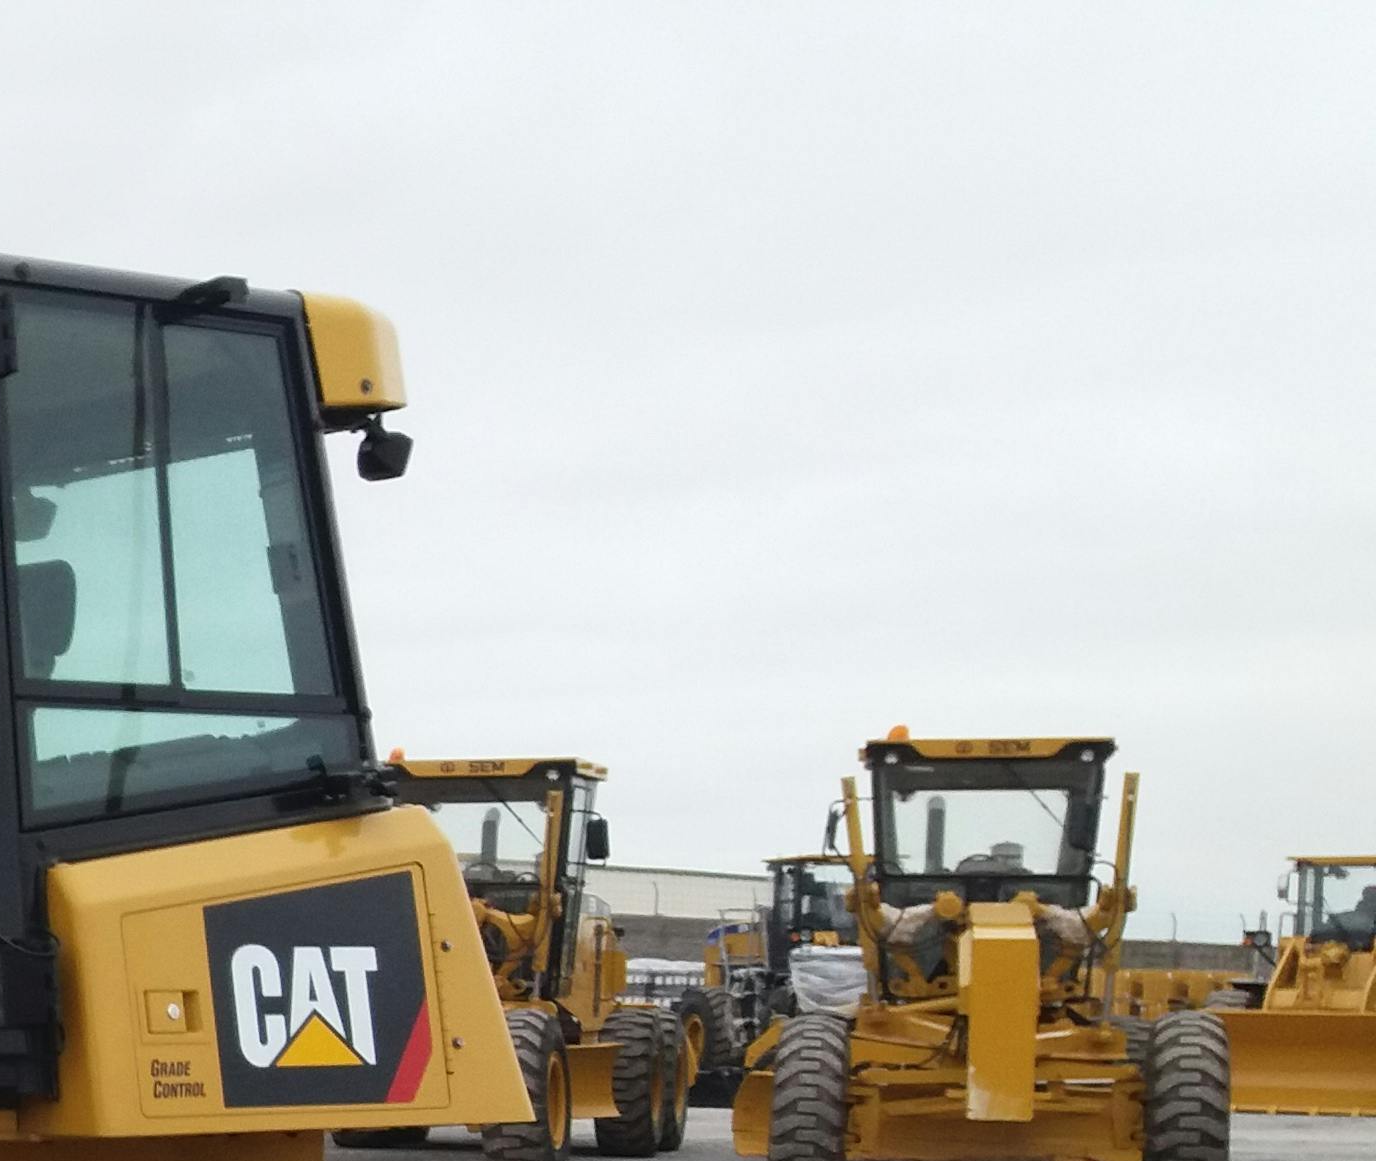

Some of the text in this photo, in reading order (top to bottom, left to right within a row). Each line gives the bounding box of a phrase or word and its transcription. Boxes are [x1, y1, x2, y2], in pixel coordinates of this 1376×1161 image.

[468, 760, 505, 774] SEM
[231, 943, 378, 1068] CAT
[150, 1058, 191, 1078] GRADE
[153, 1080, 206, 1099] CONTROL
